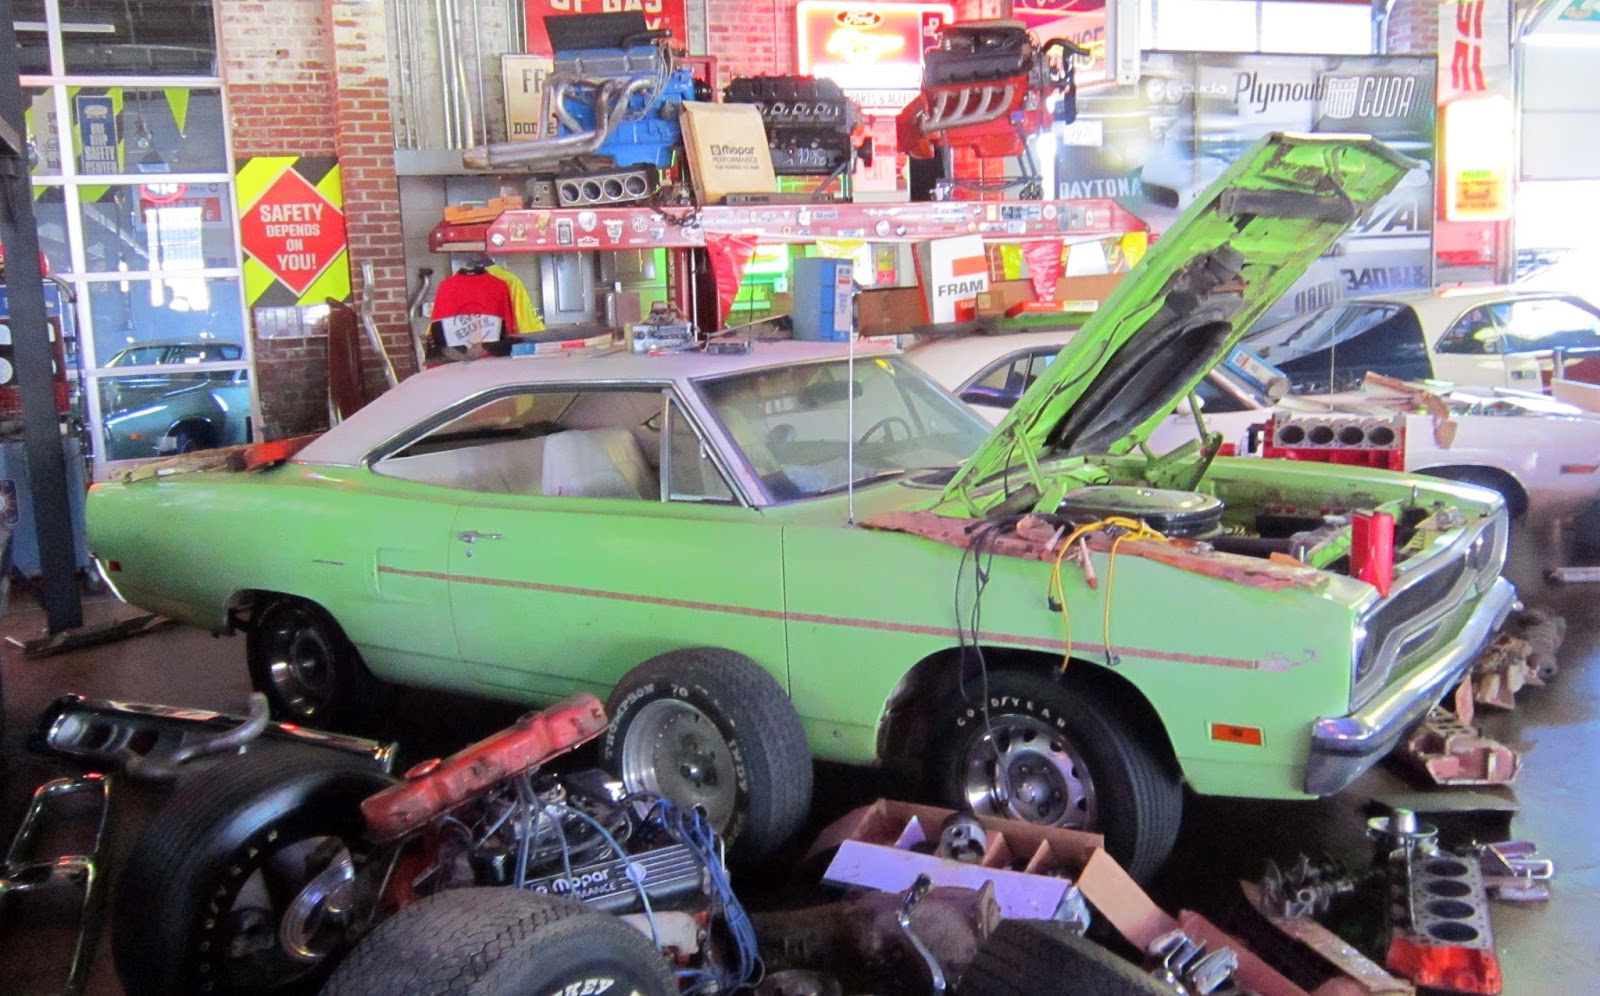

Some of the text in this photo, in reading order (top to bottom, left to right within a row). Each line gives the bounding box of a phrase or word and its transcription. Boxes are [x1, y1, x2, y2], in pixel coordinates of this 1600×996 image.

[843, 10, 877, 26] Ford
[1359, 76, 1416, 119] CUDA
[513, 122, 555, 135] DODE
[1060, 178, 1141, 199] DAYTONA
[259, 203, 324, 223] SAFETY
[265, 223, 320, 238] DEPENDS
[285, 238, 304, 252] ON
[276, 253, 317, 272] YOU!
[937, 279, 984, 298] FRAM
[671, 684, 689, 697] 70
[957, 696, 1066, 728] GODYEAR
